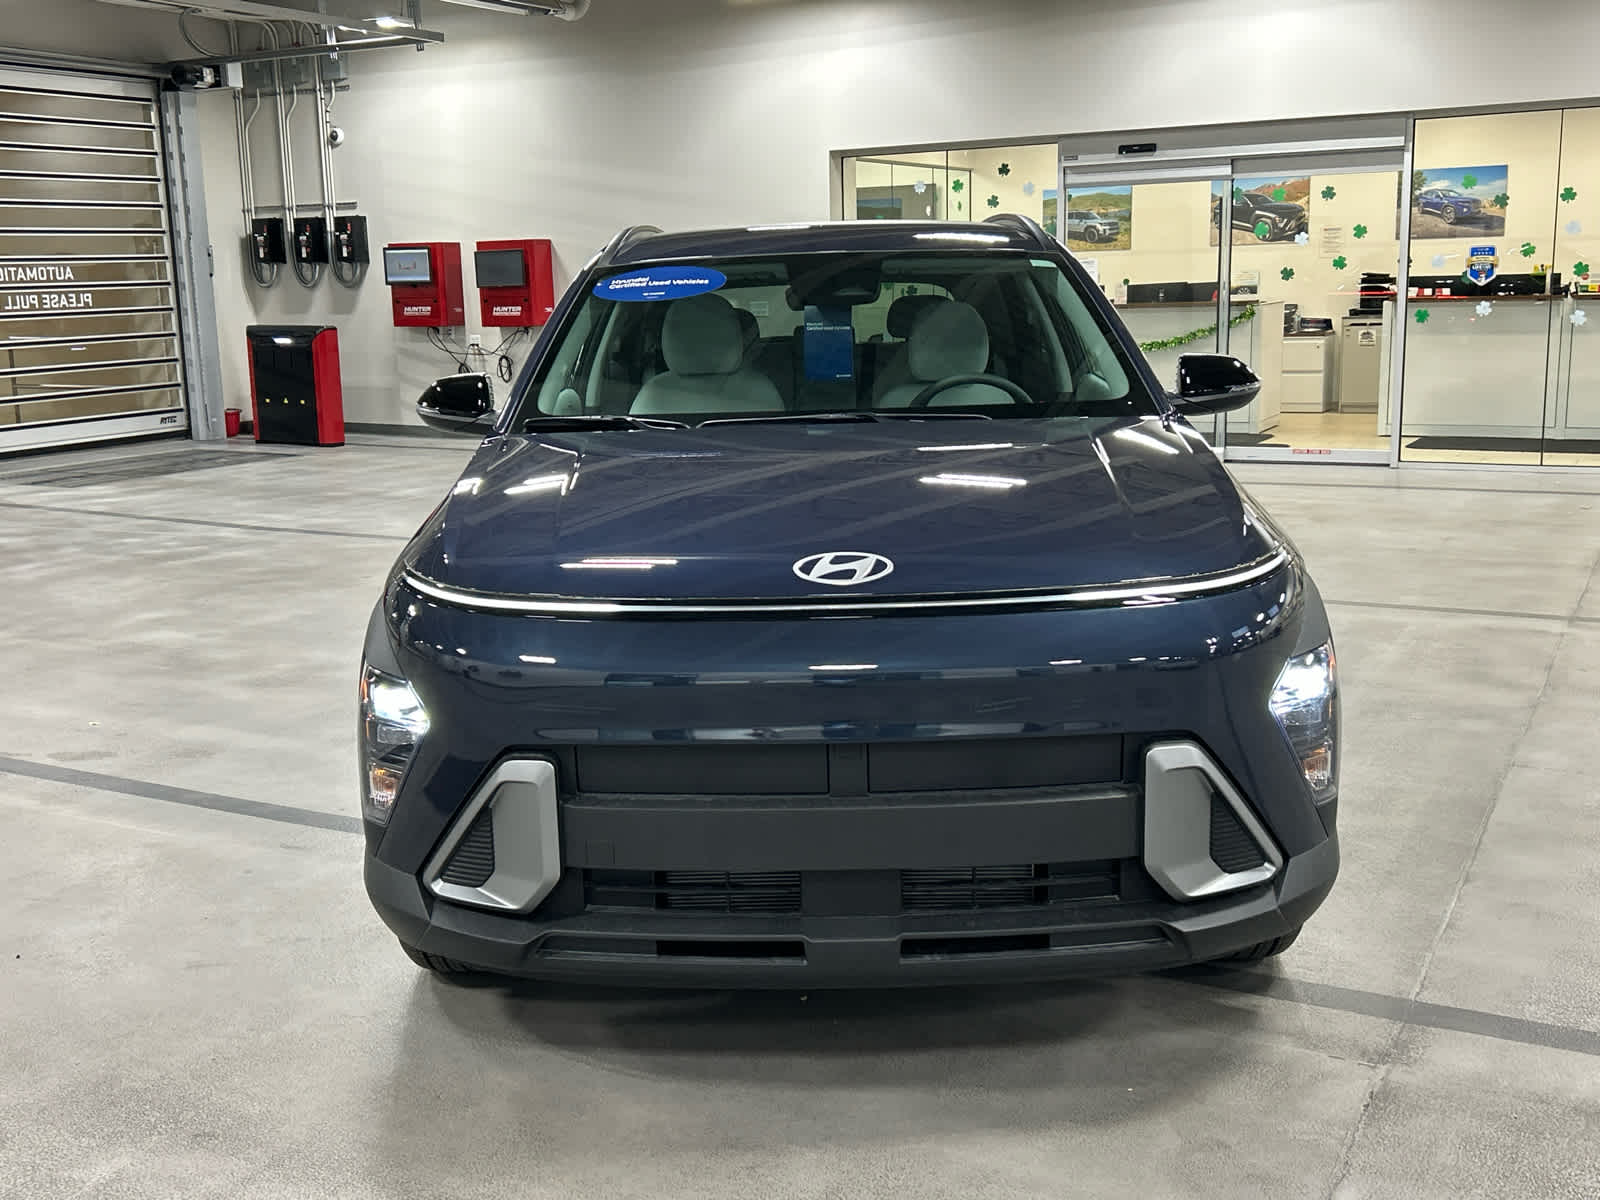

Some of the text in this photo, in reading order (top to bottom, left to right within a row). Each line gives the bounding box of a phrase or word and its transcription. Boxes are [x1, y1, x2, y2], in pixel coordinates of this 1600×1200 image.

[608, 281, 648, 290] Certified
[672, 278, 709, 286] Vehicles
[611, 276, 650, 285] Hyundai
